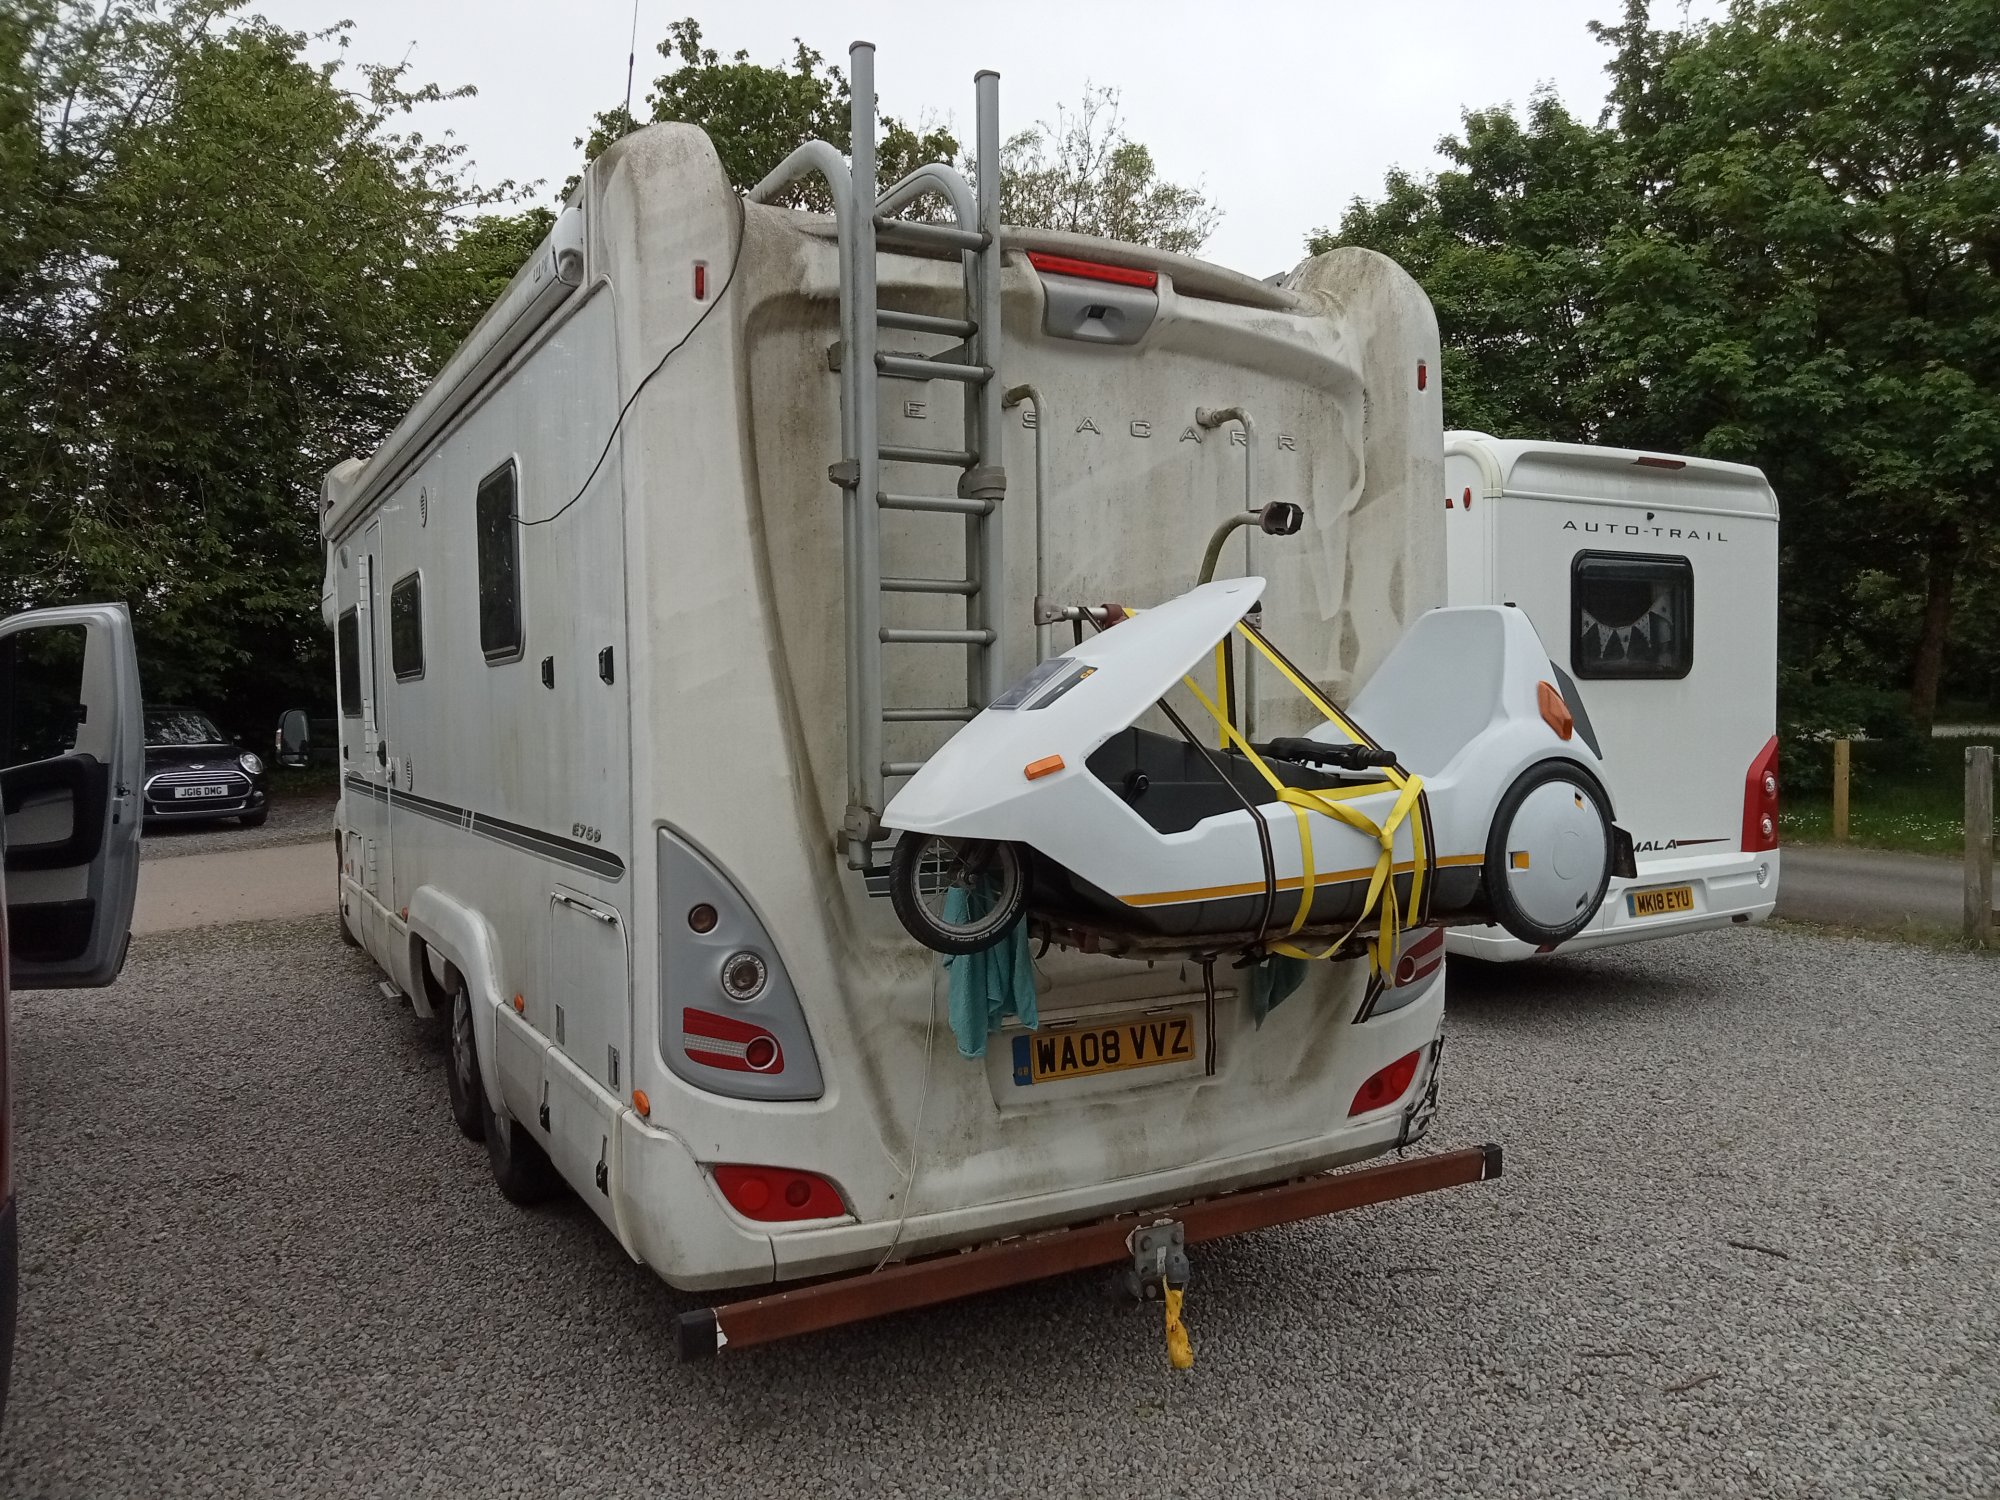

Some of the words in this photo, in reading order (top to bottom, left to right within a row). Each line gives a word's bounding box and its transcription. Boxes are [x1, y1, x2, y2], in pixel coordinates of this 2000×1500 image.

[1562, 520, 1728, 542] AUTO-TRAIL
[181, 787, 202, 797] JG16
[1636, 891, 1665, 914] MK18
[1666, 889, 1690, 909] EYU
[1036, 1029, 1121, 1075] WA08
[1130, 1020, 1189, 1060] VVZ
